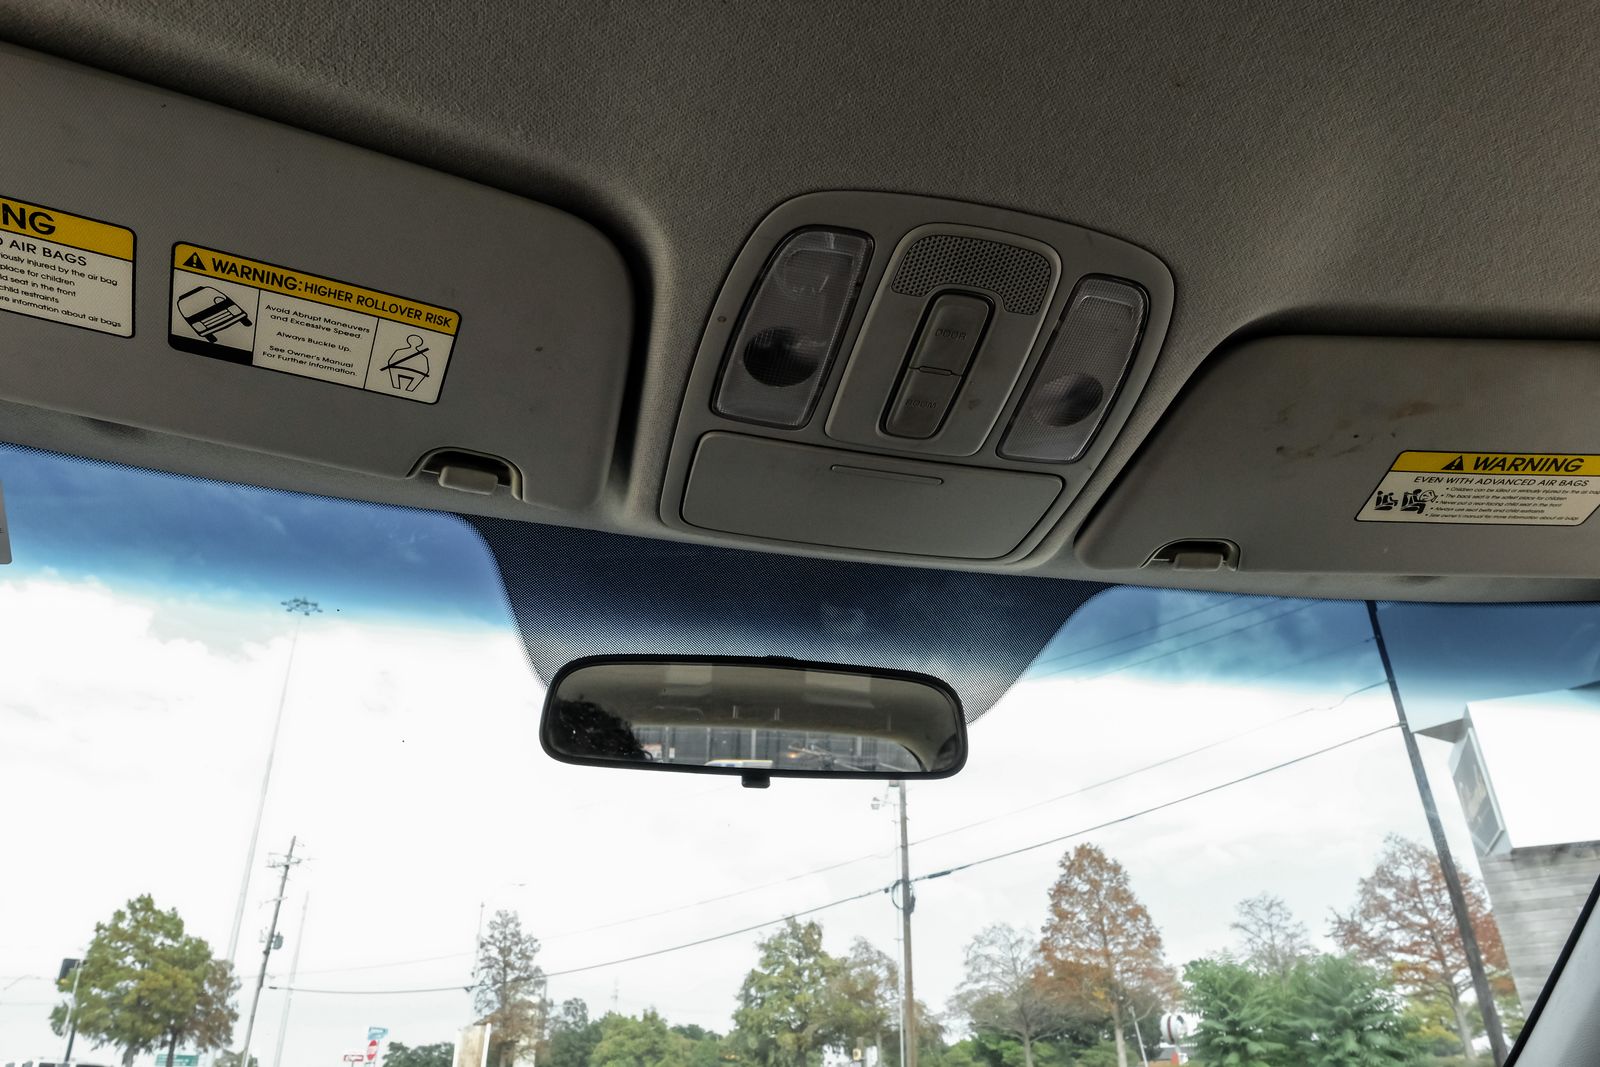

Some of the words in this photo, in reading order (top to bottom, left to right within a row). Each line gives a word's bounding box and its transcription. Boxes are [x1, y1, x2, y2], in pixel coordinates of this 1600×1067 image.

[2, 203, 56, 236] NG
[9, 239, 36, 254] AIR
[43, 247, 87, 266] BAGS
[0, 253, 25, 264] iously
[27, 258, 56, 270] injured
[58, 265, 70, 275] by
[71, 269, 85, 278] the
[88, 273, 98, 281] air
[100, 275, 118, 287] bag
[27, 269, 39, 278] for
[41, 273, 75, 286] children
[10, 277, 29, 286] seat
[40, 283, 55, 292] the
[57, 287, 76, 297] front
[21, 290, 59, 303] restraints
[212, 257, 303, 292] WARNING:
[304, 282, 353, 303] HIGHER
[356, 295, 423, 321] ROLLOVER
[426, 312, 453, 328] RISK
[12, 297, 59, 313] information
[61, 308, 86, 319] about
[100, 317, 122, 328] bags
[265, 304, 290, 315] Avoid
[292, 310, 322, 322] Abrupt
[323, 317, 370, 333] Maneuvers
[270, 314, 288, 322] and
[290, 317, 331, 332] Excessive
[276, 331, 305, 343] Always
[308, 337, 336, 348] Buckle
[338, 344, 352, 353] Up.
[262, 351, 276, 359] For
[278, 354, 308, 366] Further
[269, 345, 285, 353] See
[287, 348, 320, 361] Owner's
[322, 356, 354, 368] Manual
[1473, 457, 1585, 472] WARNING
[1446, 477, 1474, 485] WITH
[1475, 478, 1537, 486] ADVANCED
